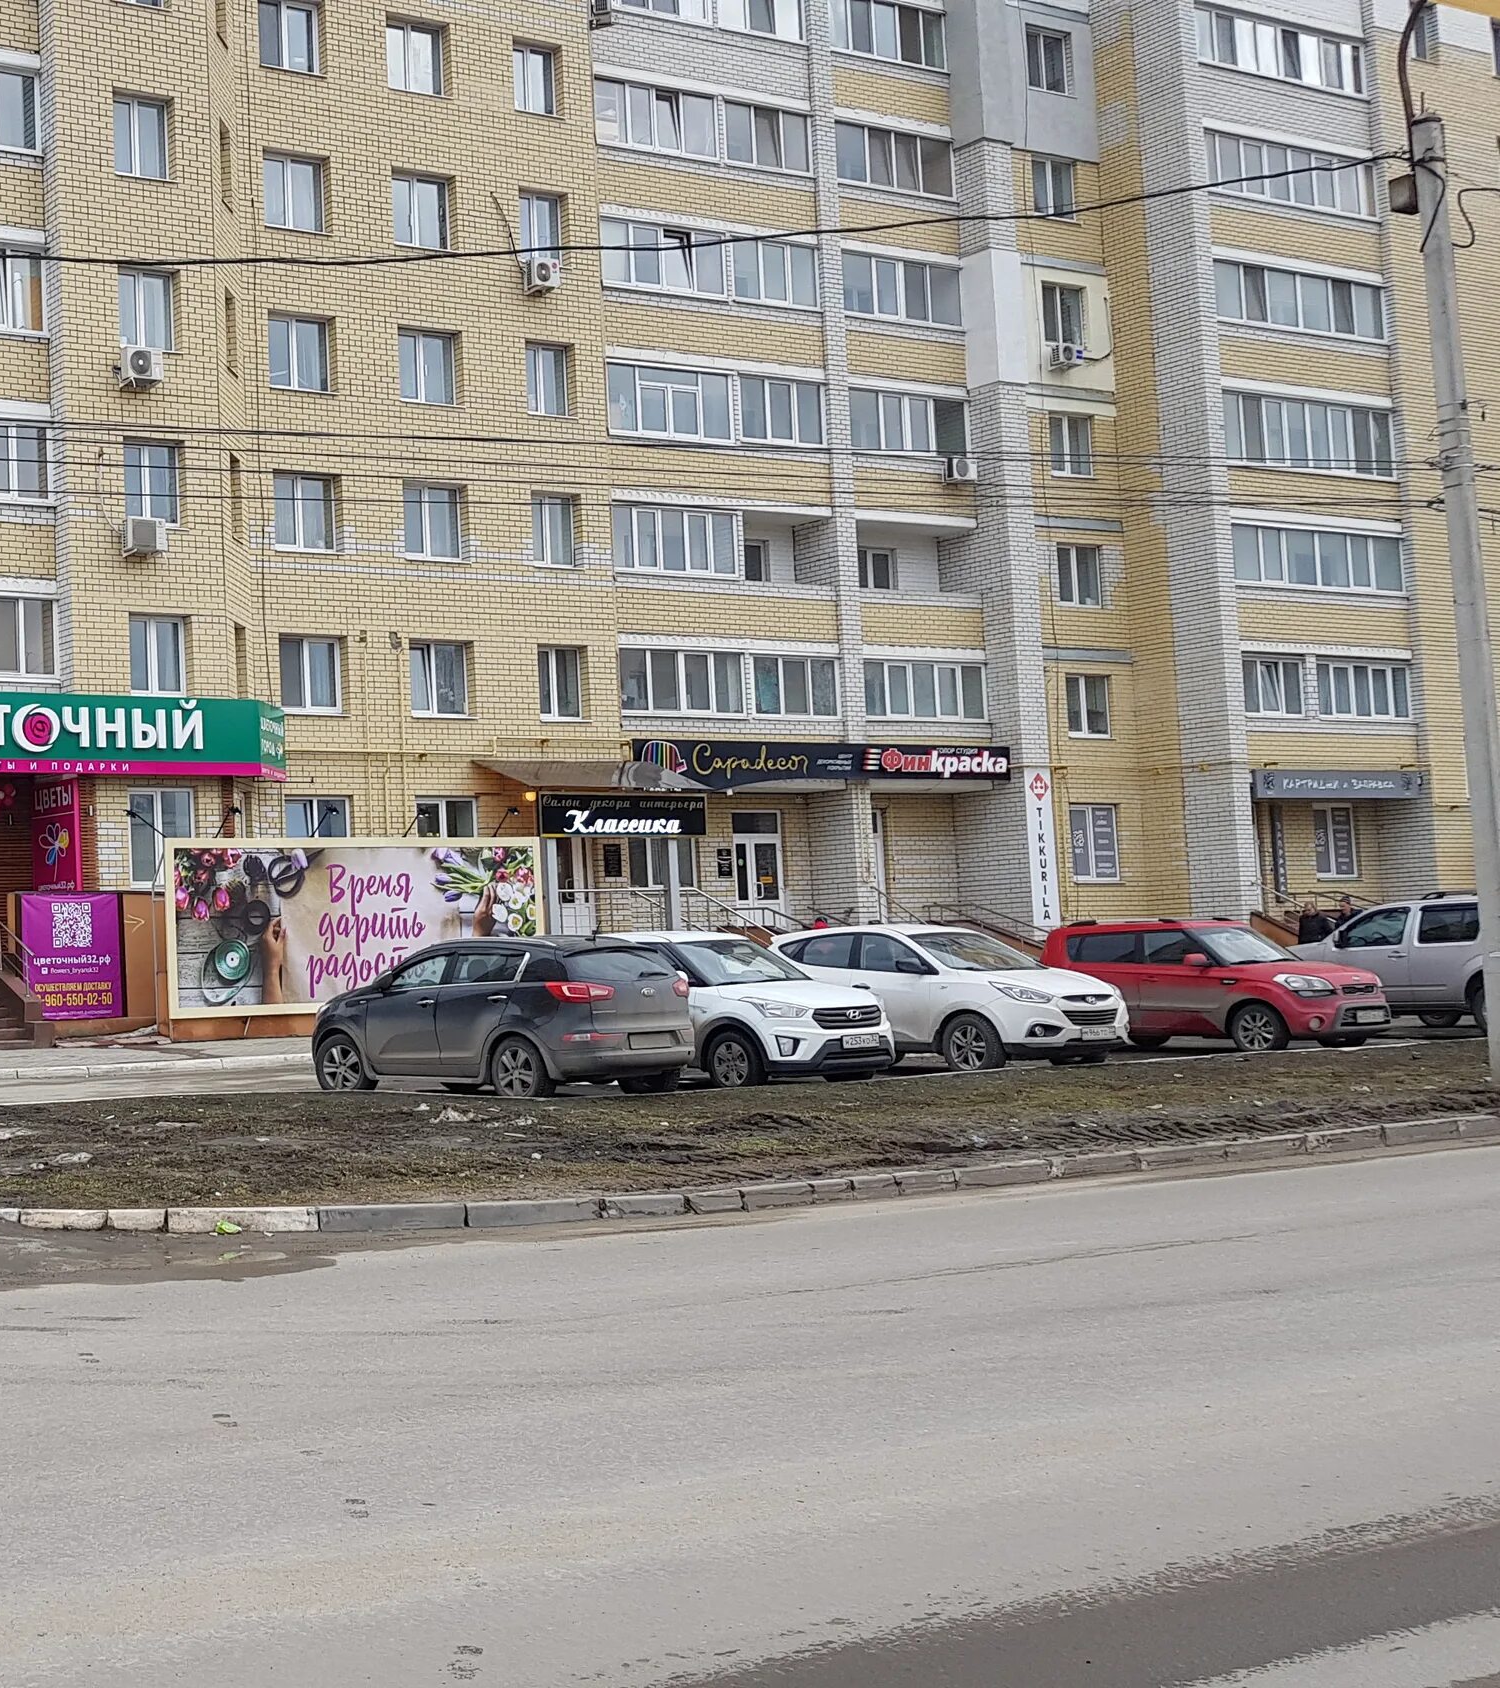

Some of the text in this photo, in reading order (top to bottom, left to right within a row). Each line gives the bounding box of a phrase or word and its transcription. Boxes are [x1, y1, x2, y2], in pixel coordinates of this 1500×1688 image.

[30, 761, 37, 770] И
[51, 761, 130, 773] ПОДАРКИ
[34, 784, 72, 813] ЦВЕТЫ
[542, 795, 581, 808] Салон
[639, 800, 704, 812] интерьера
[563, 809, 682, 834] Классика
[1036, 807, 1051, 920] TIKKURILA
[325, 864, 414, 916] Время
[318, 908, 426, 956] дарить
[33, 954, 111, 966] цветочный32.рф
